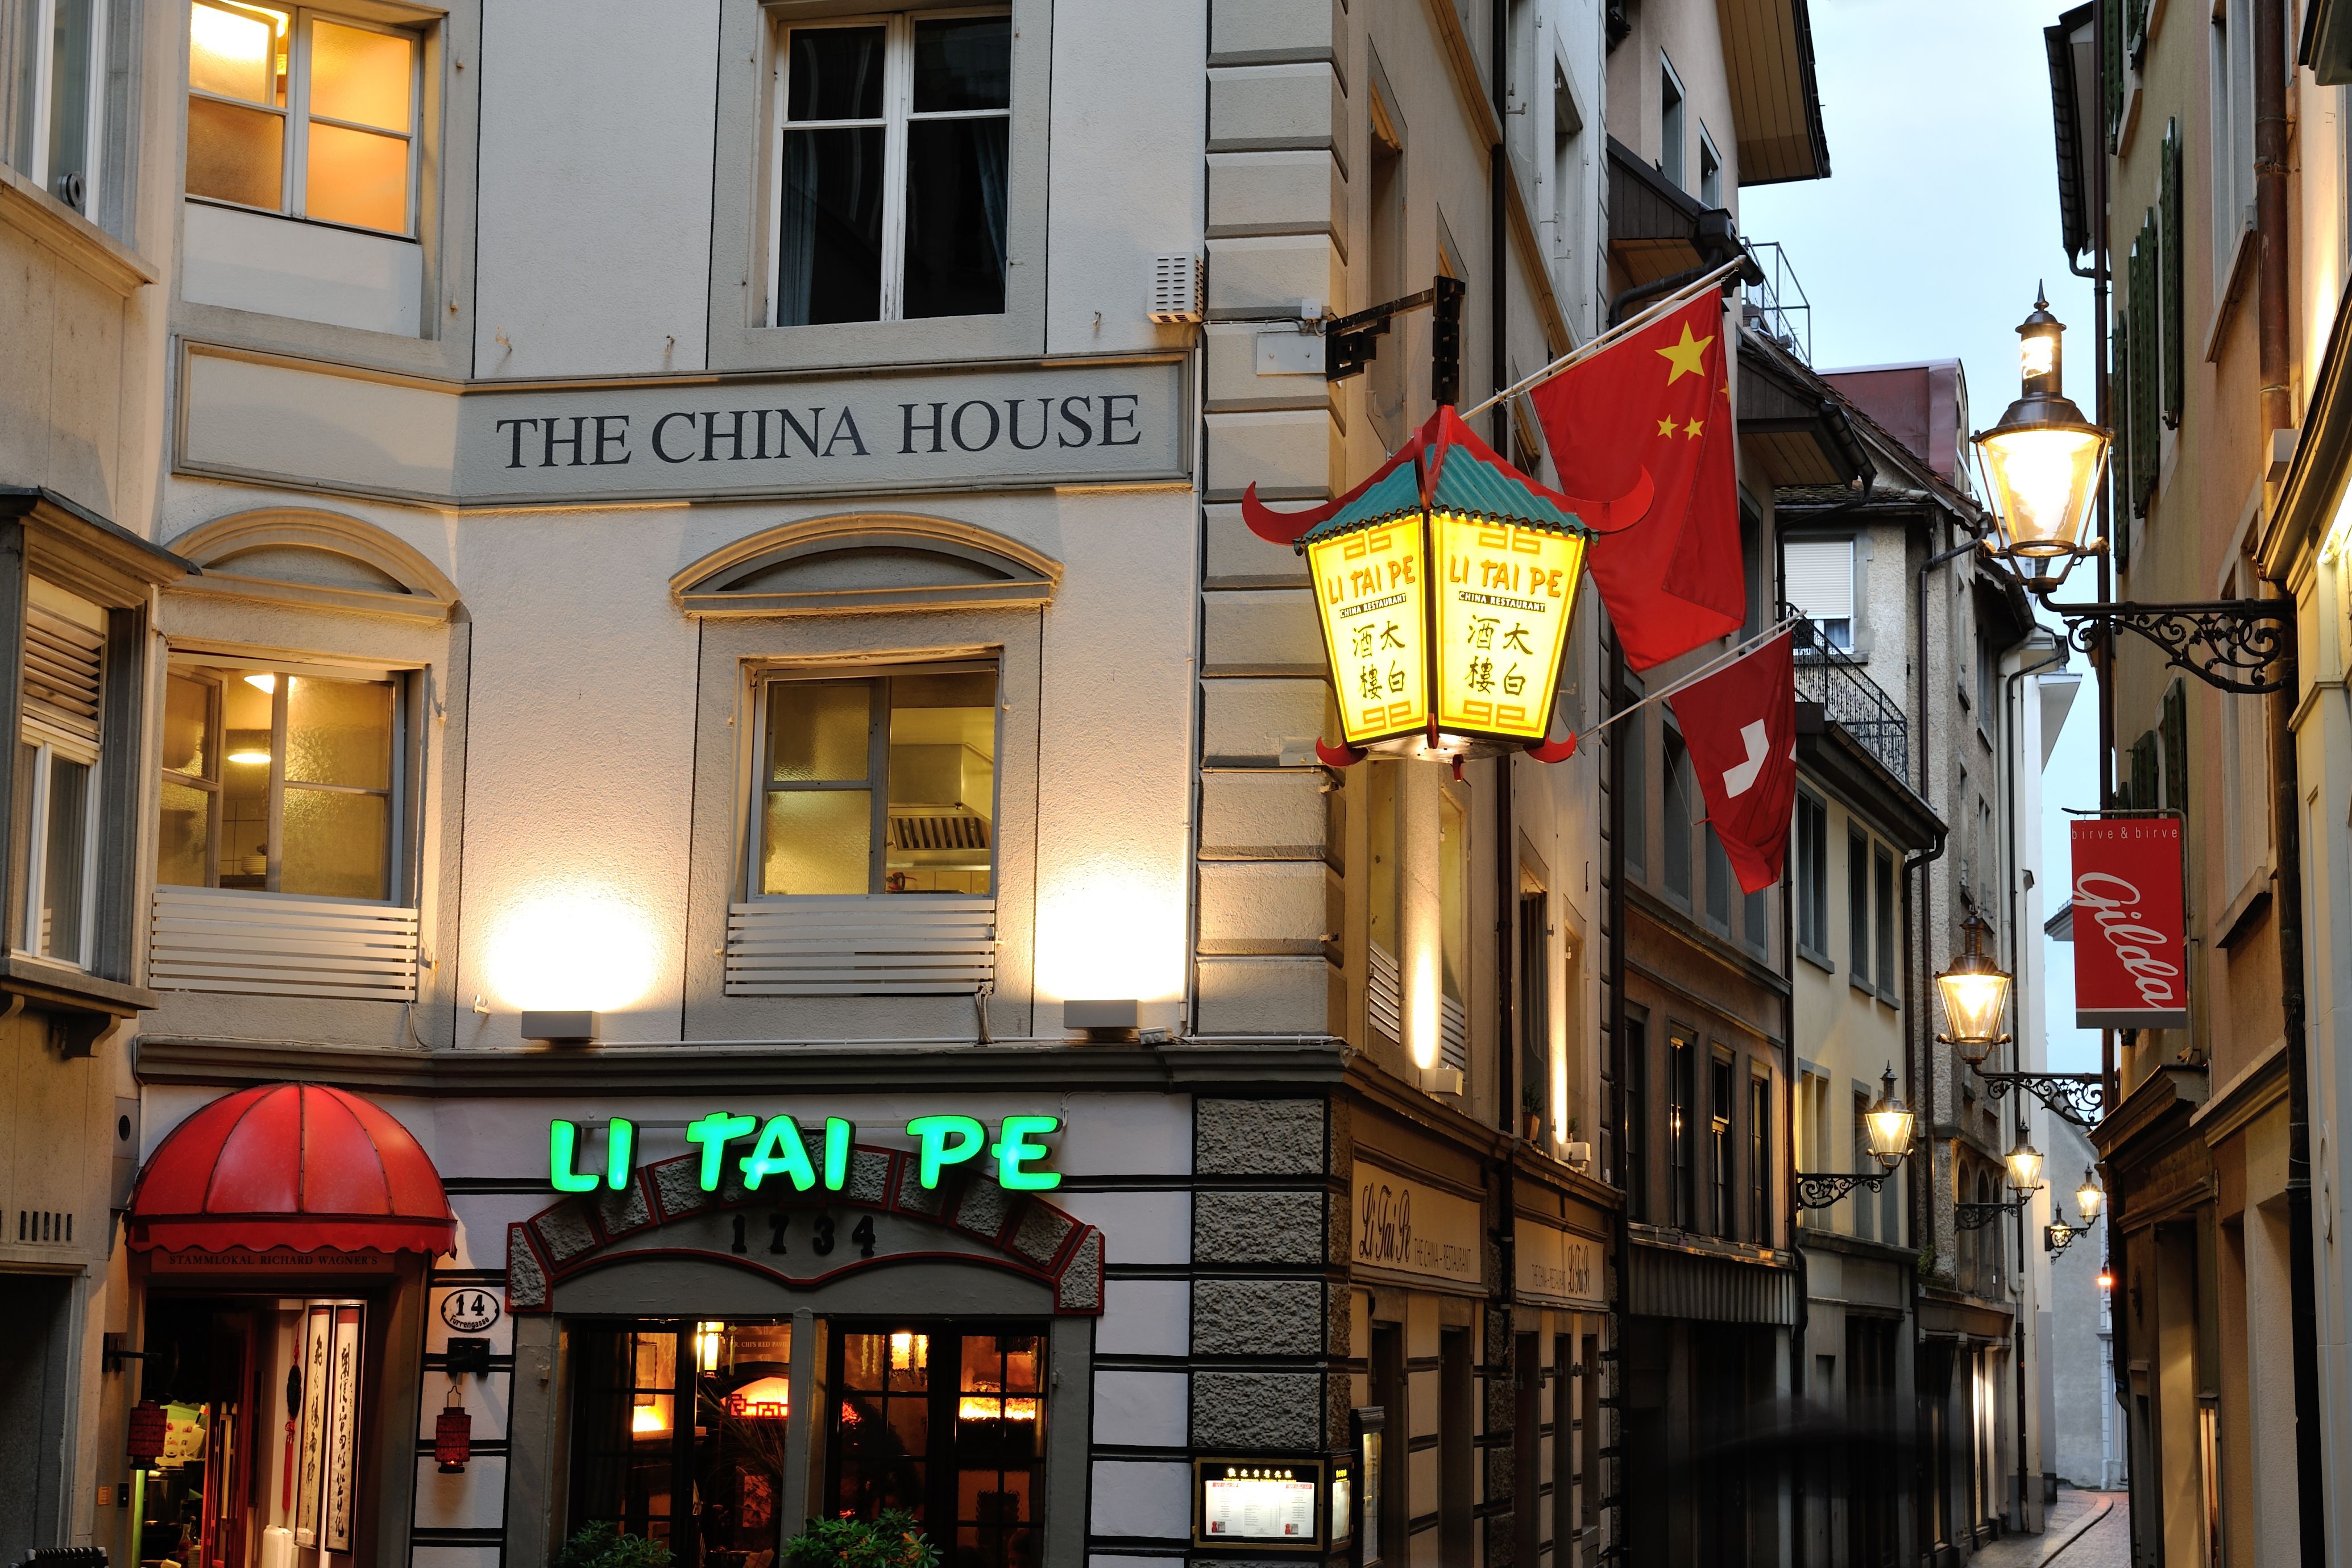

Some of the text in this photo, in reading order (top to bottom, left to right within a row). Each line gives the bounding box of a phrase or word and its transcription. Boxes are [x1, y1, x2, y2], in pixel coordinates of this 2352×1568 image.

[495, 394, 1142, 468] THE CHINA HOUSE
[1328, 555, 1416, 604] LI TAI PE
[1449, 554, 1563, 598] LI TAI PE
[1340, 594, 1407, 618] CHINA RESTAURANT
[1459, 592, 1546, 612] CHINA RESTAURANT
[2071, 828, 2114, 840] birve
[2135, 826, 2178, 839] birve
[2072, 872, 2179, 1008] Gilda
[549, 1112, 1063, 1192] LI TAI PE
[731, 1213, 876, 1256] 1734
[169, 1255, 378, 1265] STAMMLOKAL RICHARD WAGNER'S
[449, 1314, 490, 1329] Furrengasse
[455, 1294, 485, 1316] 14
